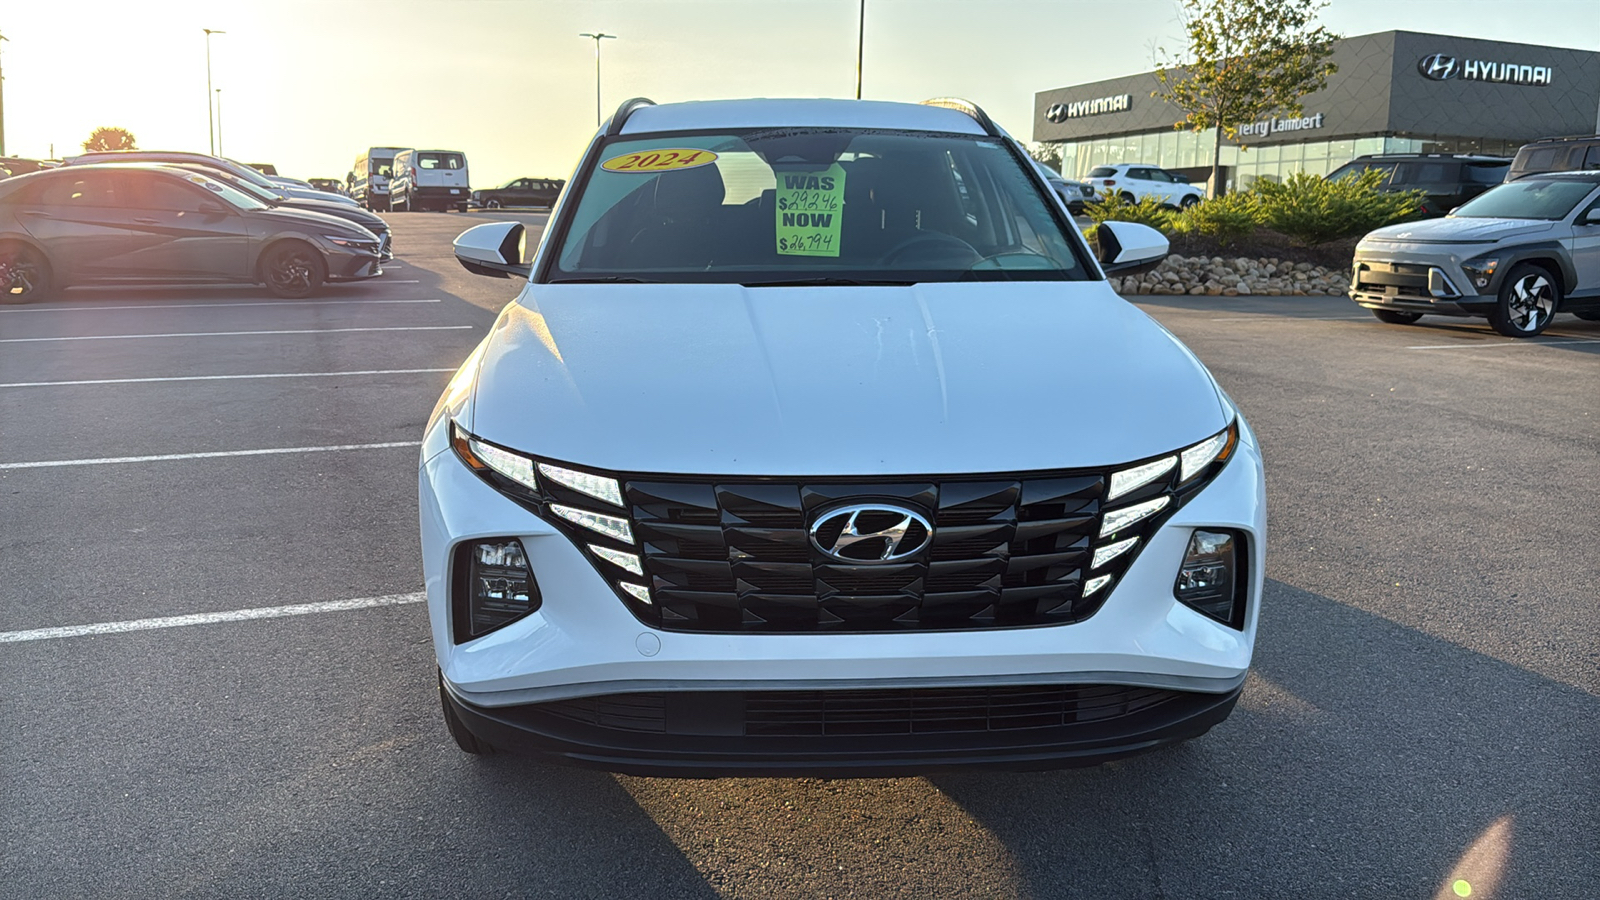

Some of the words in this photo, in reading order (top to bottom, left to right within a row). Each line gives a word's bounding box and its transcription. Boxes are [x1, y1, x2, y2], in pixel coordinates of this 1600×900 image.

[1464, 59, 1552, 85] HYUNDAI
[1068, 94, 1129, 117] HYUNDAI
[1271, 112, 1323, 133] Lambert
[616, 151, 703, 170] 2024
[784, 175, 835, 191] WAS
[782, 212, 833, 228] NOW
